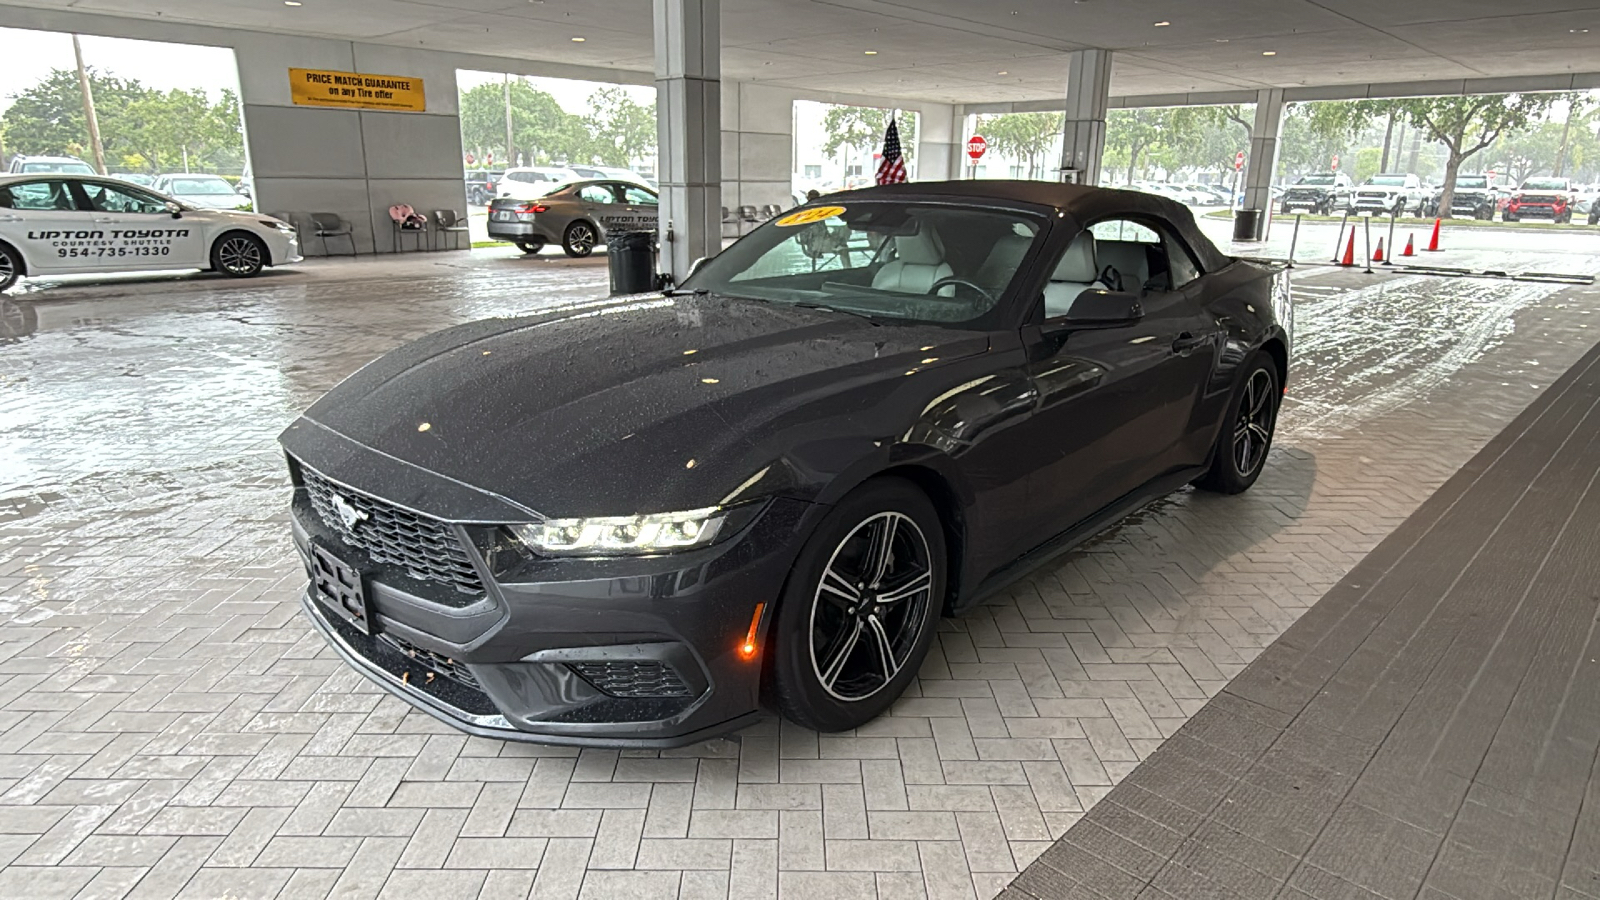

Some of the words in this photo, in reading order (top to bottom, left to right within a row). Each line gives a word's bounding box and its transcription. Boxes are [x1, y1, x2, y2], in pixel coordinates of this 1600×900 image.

[306, 73, 332, 84] PRICE
[334, 76, 363, 87] MATCH
[365, 78, 410, 90] GUARANTEE
[329, 87, 339, 95] on
[341, 88, 355, 97] any
[358, 88, 372, 98] Tire
[375, 90, 393, 99] offer
[967, 143, 985, 152] STOP
[28, 230, 104, 240] LIPTON
[111, 229, 189, 239] TOYOTA
[58, 246, 170, 258] 954-735-1330
